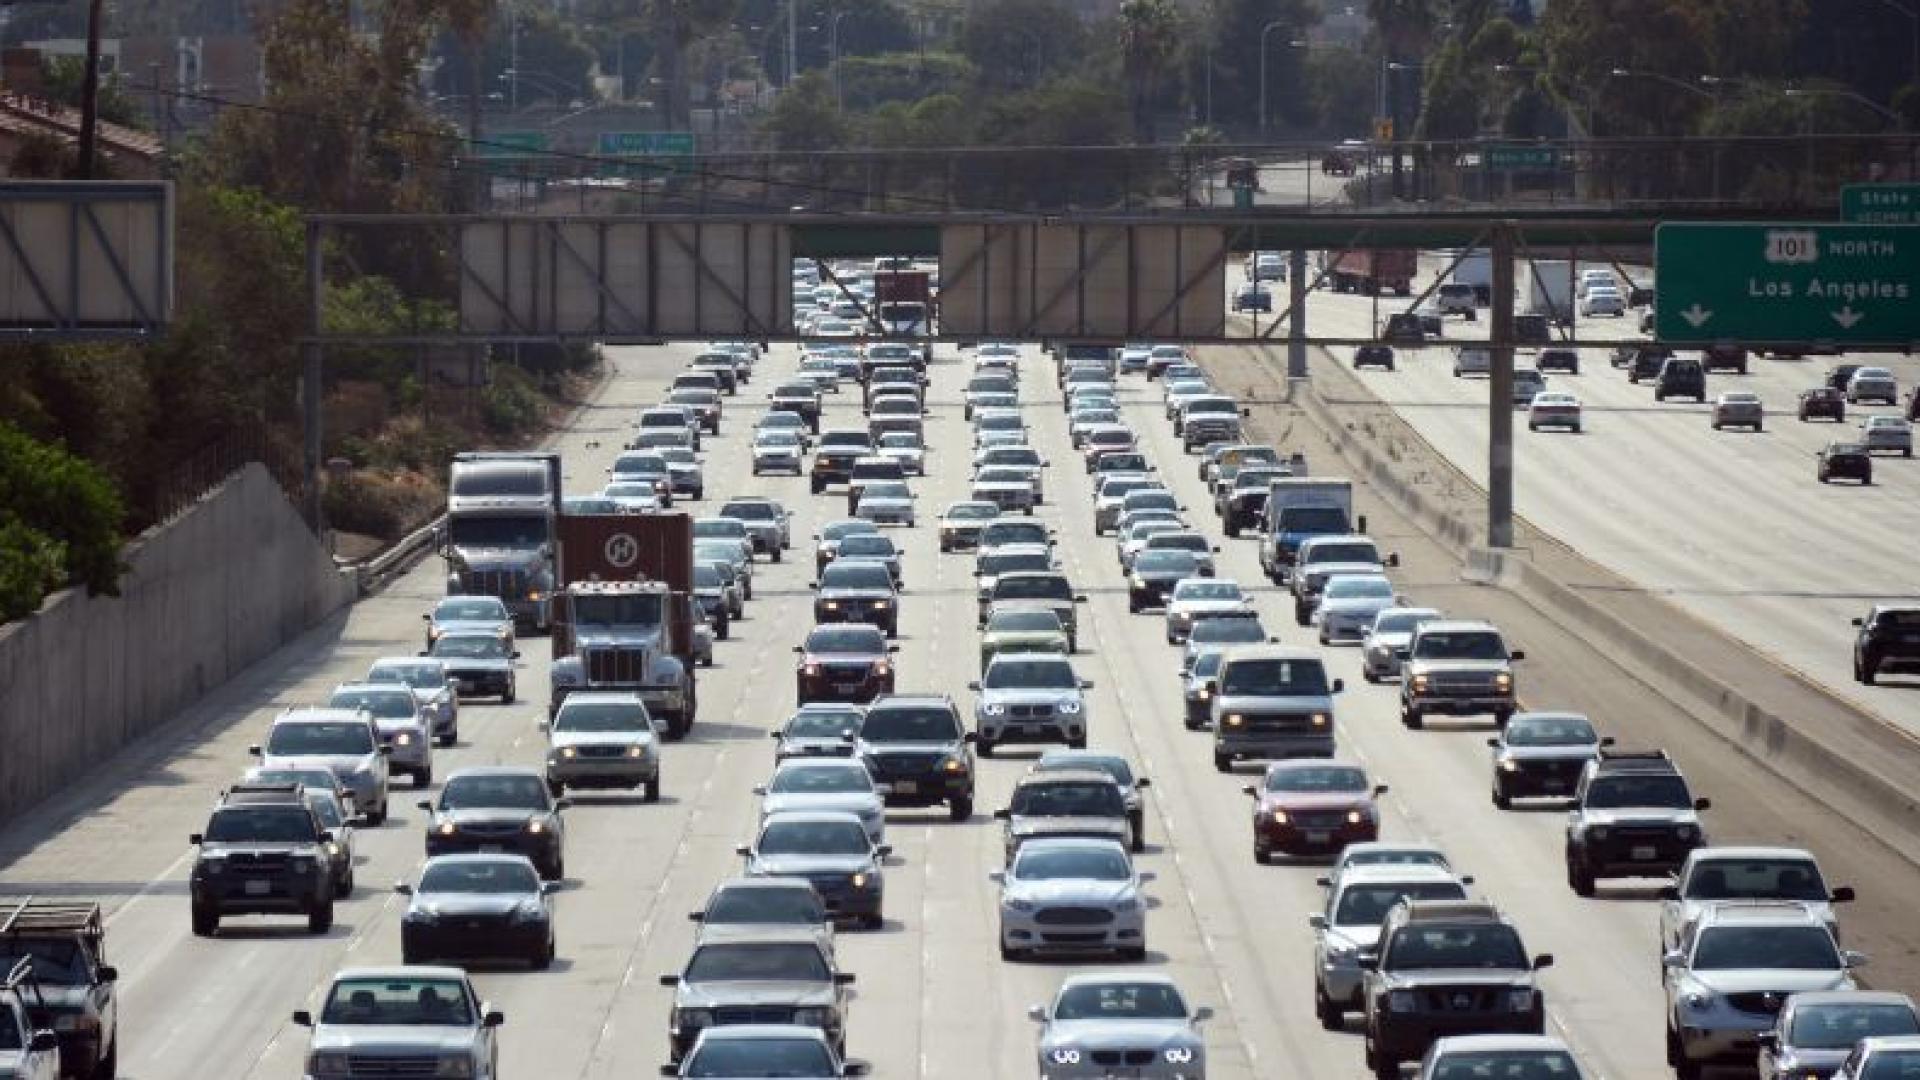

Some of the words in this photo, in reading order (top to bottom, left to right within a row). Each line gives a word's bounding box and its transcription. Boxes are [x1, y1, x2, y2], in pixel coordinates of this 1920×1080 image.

[1860, 191, 1909, 205] State
[1776, 237, 1807, 256] 101
[1829, 240, 1895, 256] NORTH
[1749, 277, 1793, 297] Los
[1806, 276, 1909, 303] Angeles
